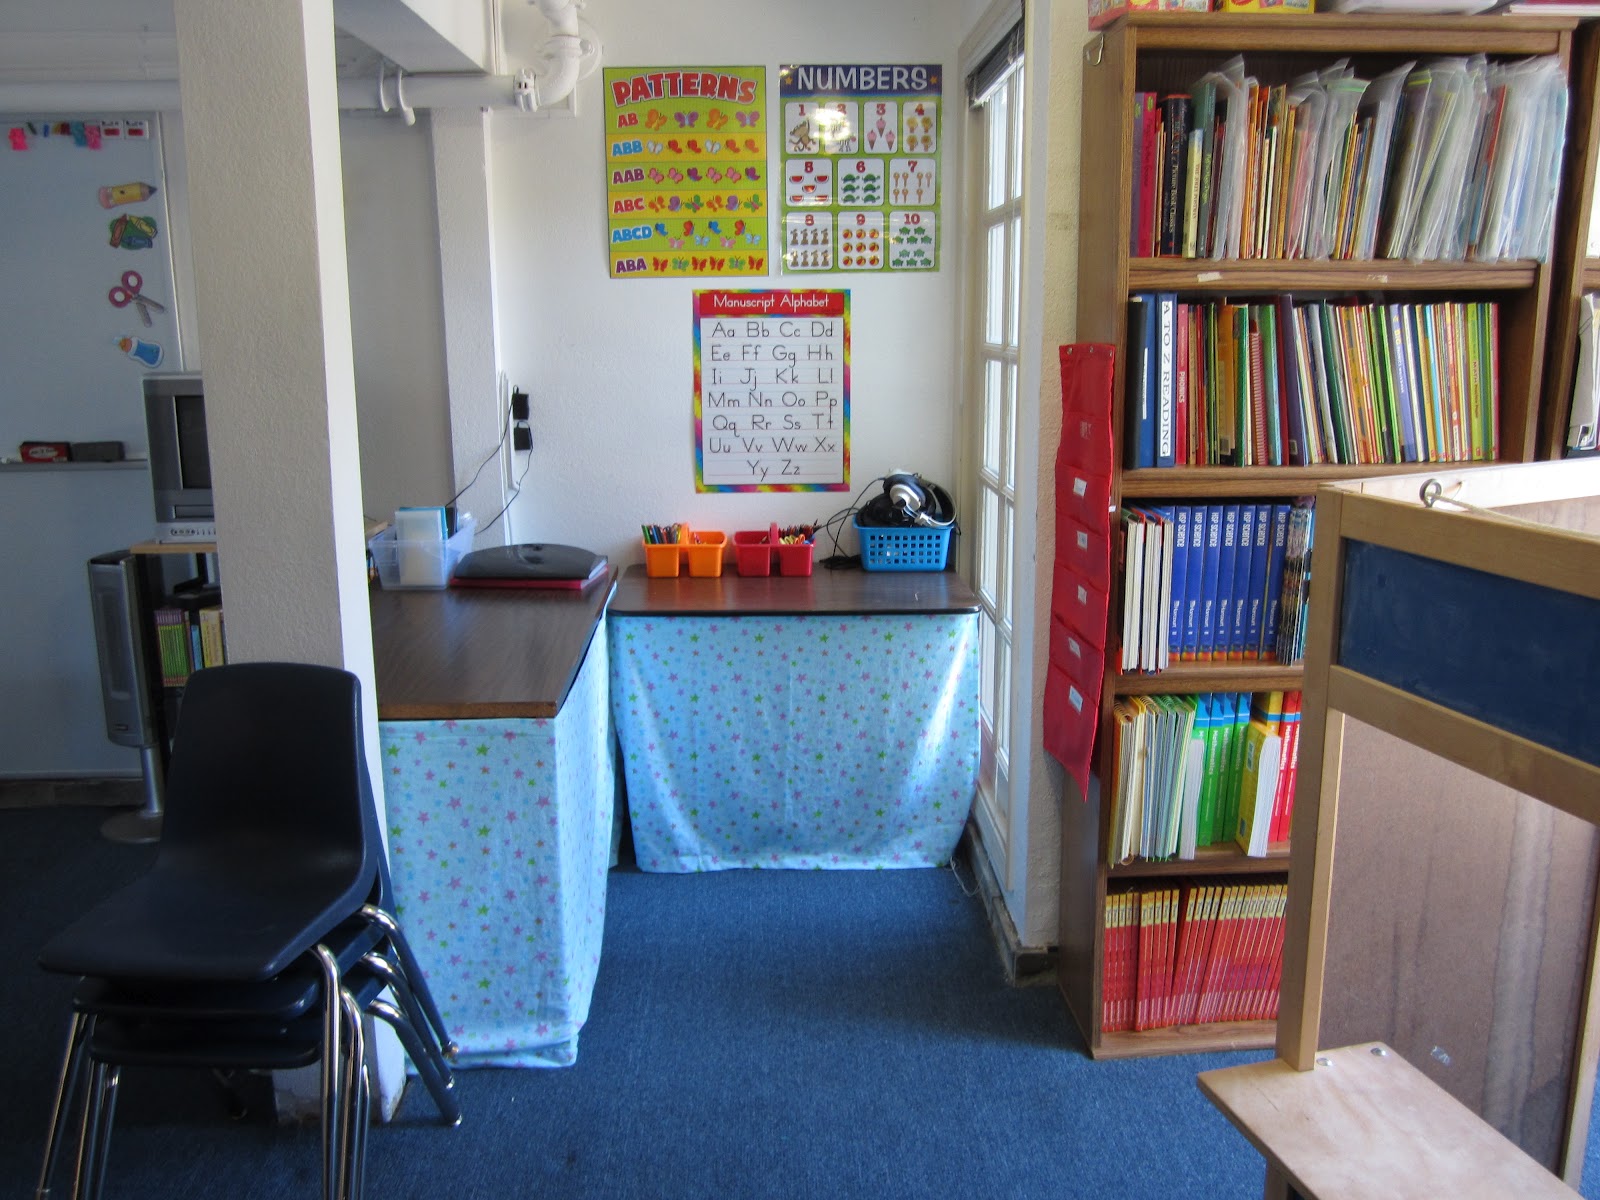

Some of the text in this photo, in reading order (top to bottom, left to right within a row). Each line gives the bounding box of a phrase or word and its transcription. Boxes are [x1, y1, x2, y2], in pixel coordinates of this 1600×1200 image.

[797, 67, 928, 91] NUMBERS
[611, 72, 757, 107] PATTERNS
[798, 104, 806, 116] 1
[876, 104, 886, 116] 3
[914, 104, 925, 116] 4
[618, 113, 638, 128] AB
[612, 140, 643, 156] ABB
[804, 160, 918, 173] 5 6 7
[613, 168, 644, 184] AAB
[613, 198, 645, 213] ABC
[804, 213, 920, 226] 8 9 10
[612, 226, 652, 243] ABCD
[616, 258, 647, 273] ABA
[713, 294, 829, 313] Manuscript Alphabet
[712, 322, 832, 338] Aa Bb Cc Dd
[712, 345, 832, 368] Ee Ff Gg Hh
[712, 368, 722, 384] Ii
[740, 368, 756, 391] Jj
[1161, 302, 1171, 456] A TO Z READING
[708, 392, 740, 407] Mm
[749, 392, 772, 407] Nn
[782, 392, 805, 407] Oo
[713, 415, 740, 437] Qq
[752, 415, 771, 430] Rr
[783, 415, 800, 430] Ss
[710, 437, 835, 453] Uu Vv Ww Xx
[747, 460, 800, 482] Yy Zz
[1179, 512, 1187, 524] HSP
[1195, 512, 1203, 524] HSP
[1211, 512, 1219, 524] HSP
[1227, 511, 1235, 524] HSP
[1243, 511, 1252, 524] HSP
[1259, 511, 1267, 523] HSP
[1278, 511, 1286, 524] HSP
[1208, 730, 1218, 775] Mathematics
[1220, 728, 1229, 772] Mathematics
[1235, 726, 1244, 770] Mathematics
[1280, 724, 1291, 770] Mathematics
